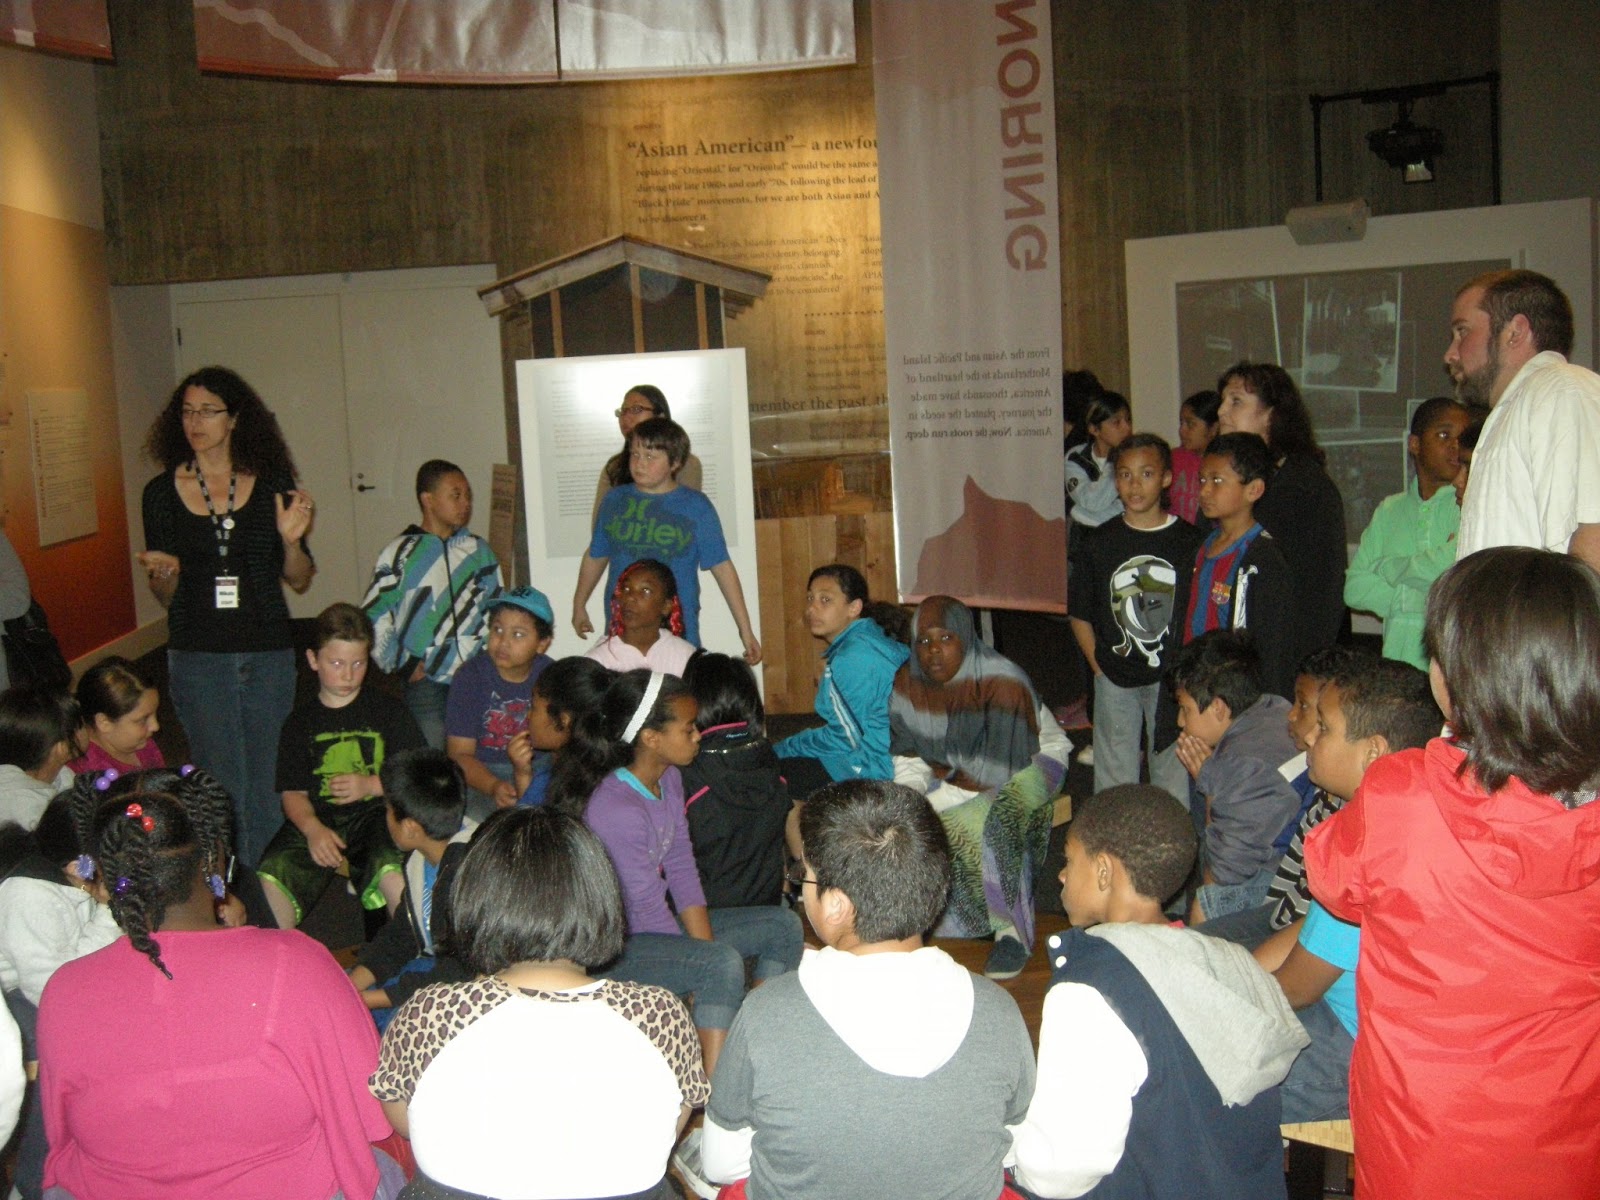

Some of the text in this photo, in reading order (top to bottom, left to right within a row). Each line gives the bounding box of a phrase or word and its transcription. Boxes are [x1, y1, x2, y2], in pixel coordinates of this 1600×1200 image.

[811, 142, 820, 150] a
[635, 167, 678, 178] replacing
[728, 163, 741, 172] for
[791, 161, 818, 170] would
[820, 160, 831, 169] be
[833, 159, 847, 168] the
[848, 160, 869, 168] same
[668, 182, 681, 191] the
[683, 182, 699, 190] late
[728, 178, 744, 188] and
[746, 178, 767, 189] early
[790, 176, 832, 187] following
[833, 175, 847, 184] the
[848, 174, 867, 184] lead
[868, 174, 877, 183] of
[755, 194, 769, 203] for
[802, 191, 823, 201] both
[827, 191, 852, 200] Asian
[854, 190, 871, 199] and
[810, 396, 833, 409] the
